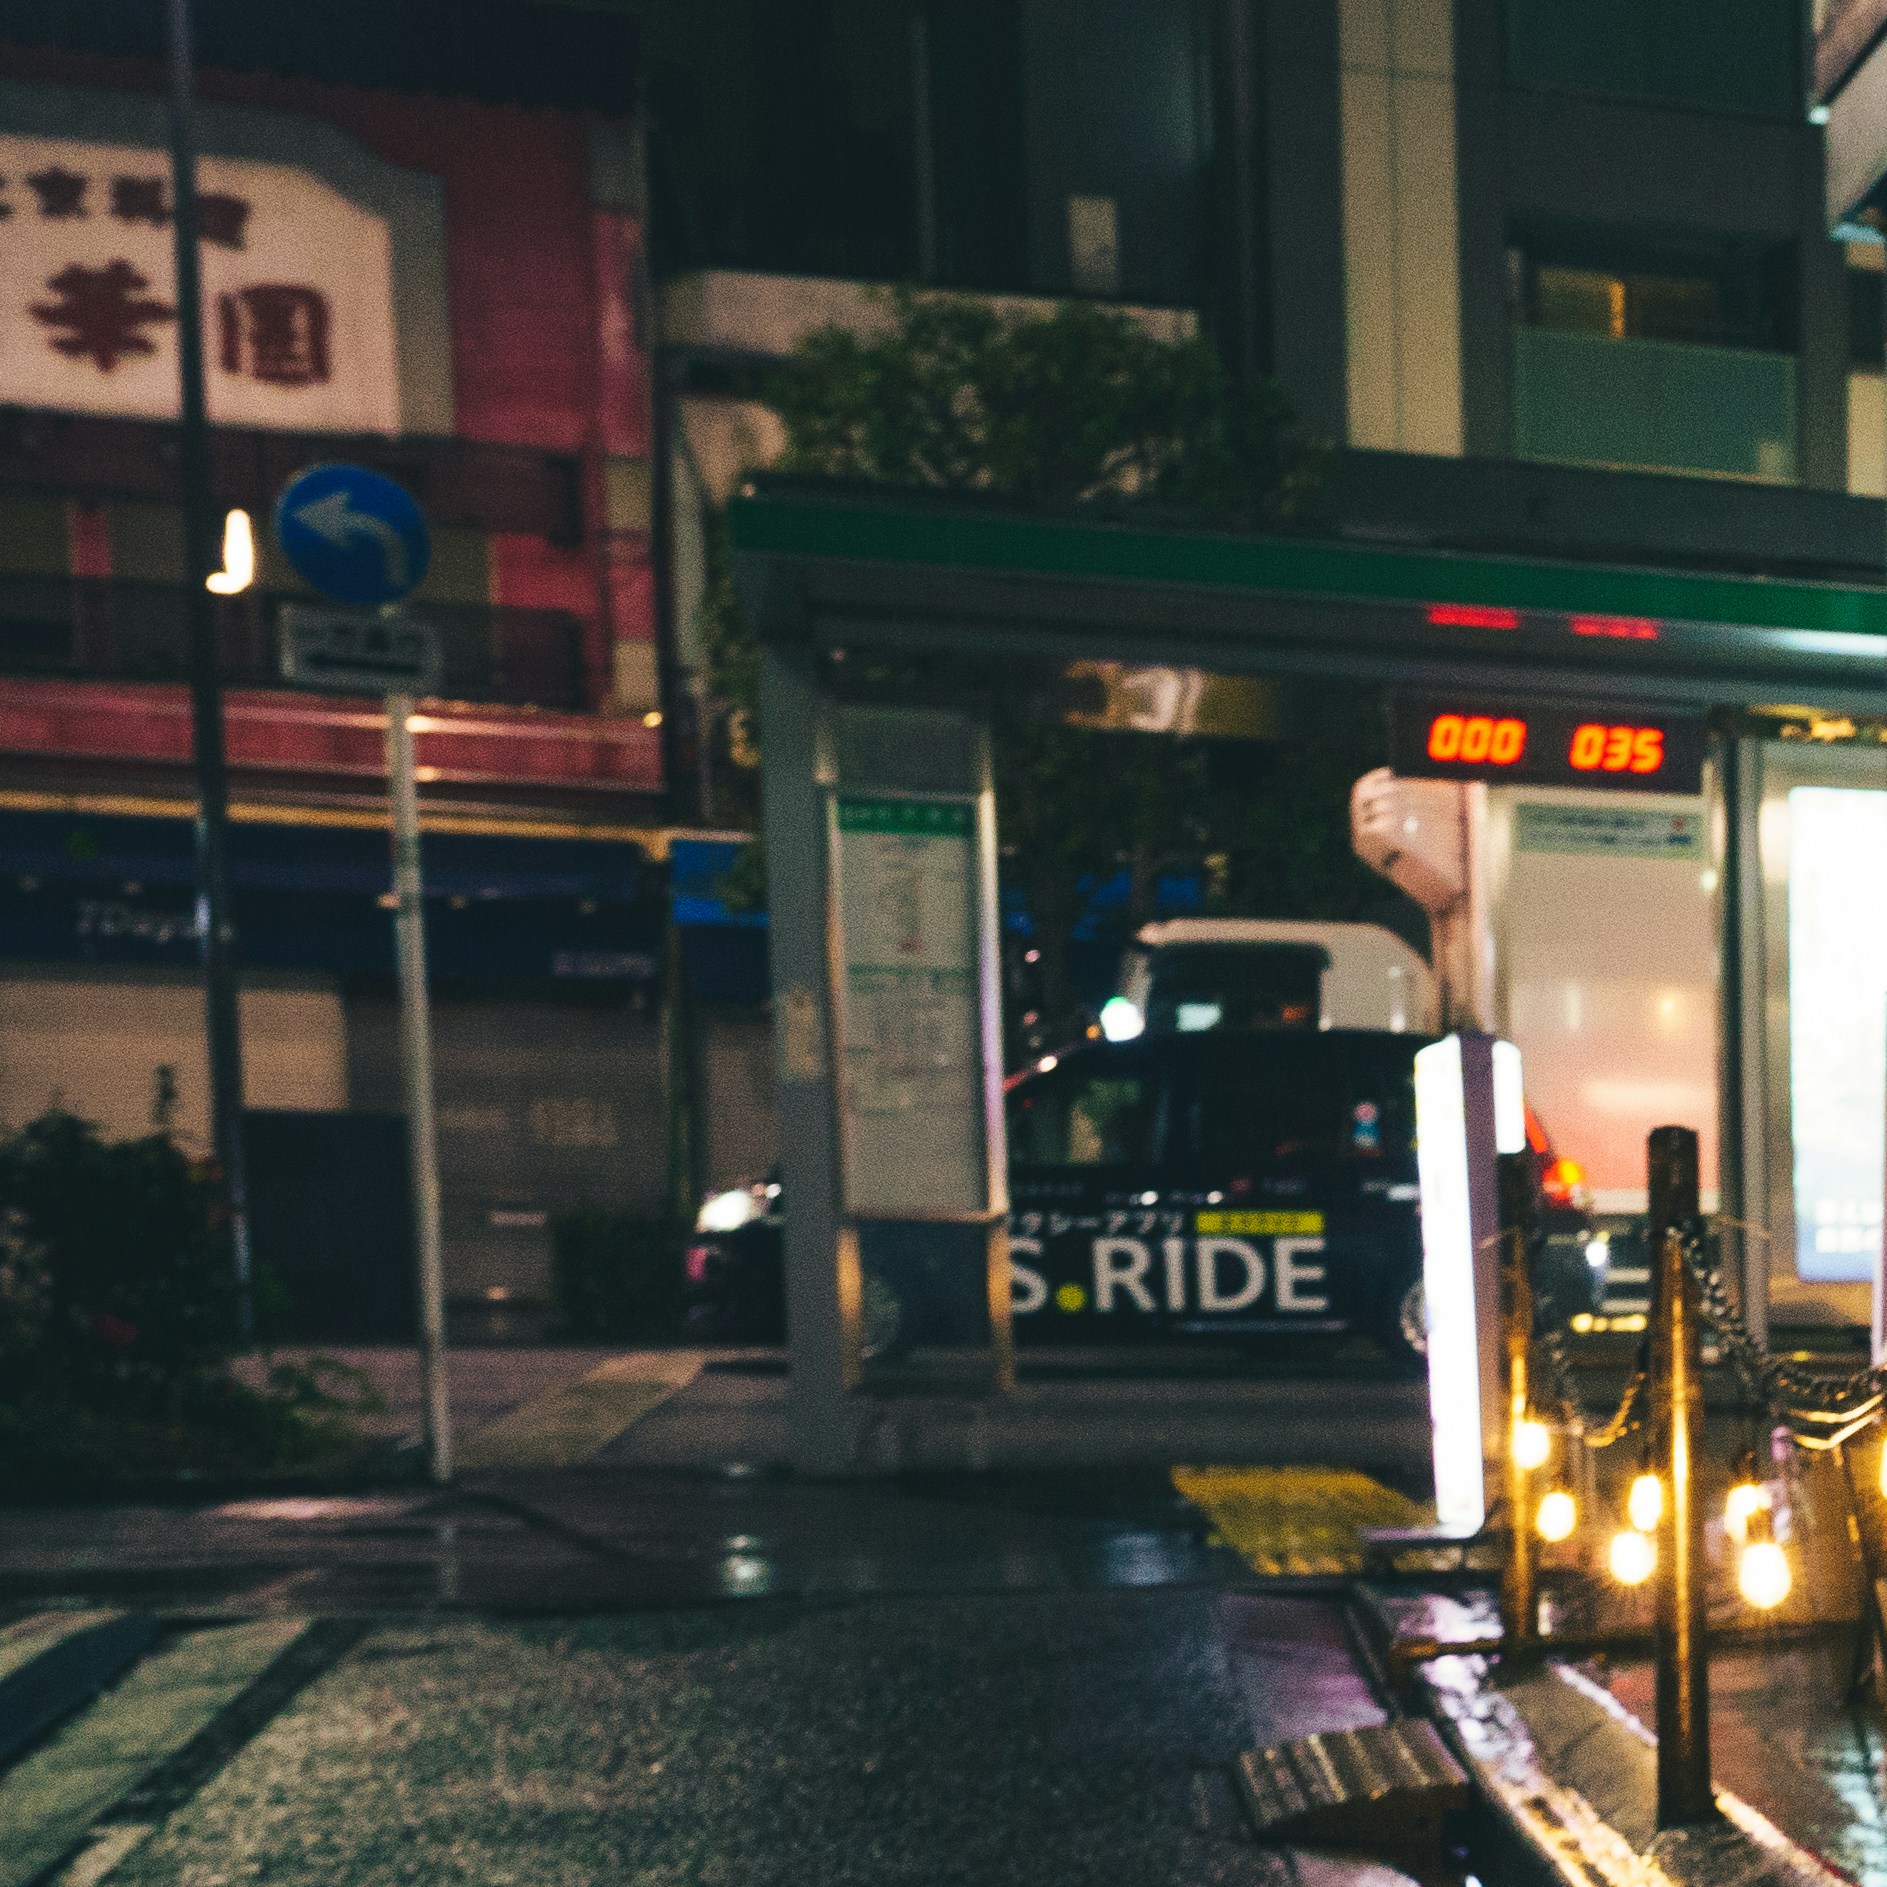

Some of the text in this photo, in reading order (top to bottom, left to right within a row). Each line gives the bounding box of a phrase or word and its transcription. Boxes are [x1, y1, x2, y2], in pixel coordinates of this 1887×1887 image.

[1427, 713, 1664, 774] 000 035
[1010, 1235, 1328, 1312] S.RIDE
